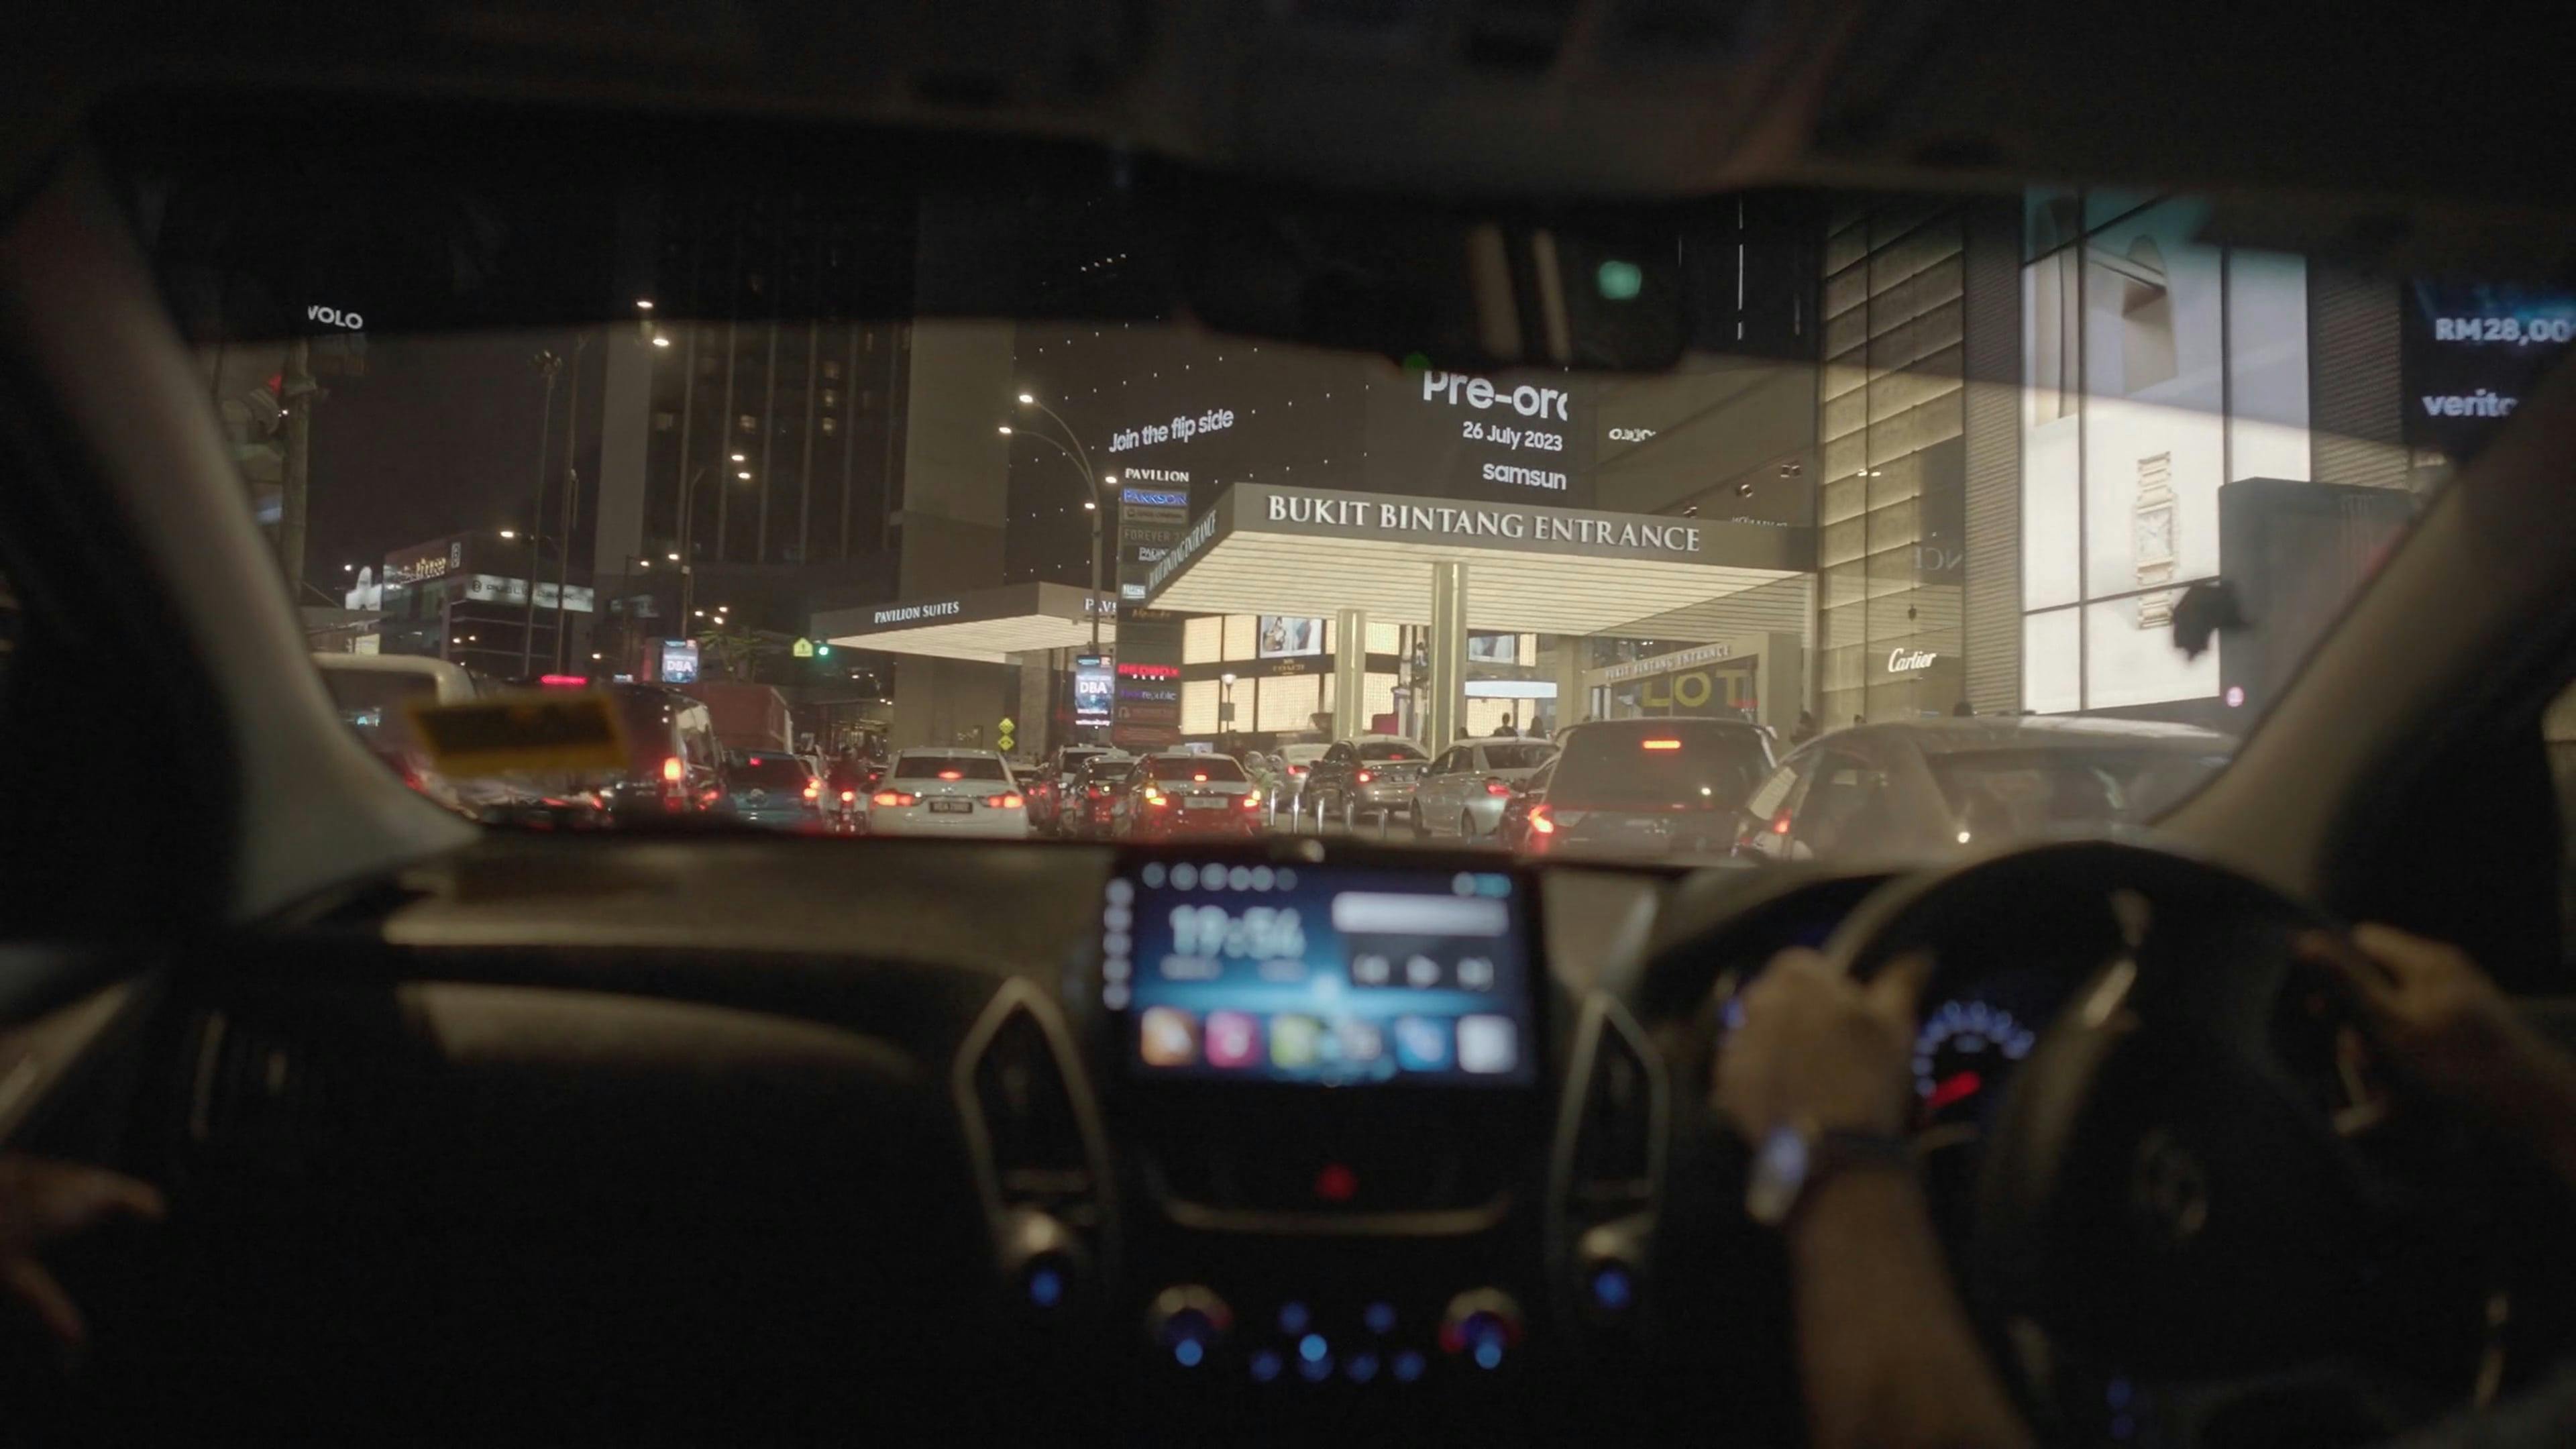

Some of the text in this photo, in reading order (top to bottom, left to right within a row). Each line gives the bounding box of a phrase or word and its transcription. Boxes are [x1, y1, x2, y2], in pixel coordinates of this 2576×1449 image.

[308, 305, 363, 329] VOLO
[1108, 409, 1234, 452] Join the flip side
[1462, 421, 1563, 451] 26 July 2023
[1125, 468, 1189, 482] PAVILION
[1483, 464, 1567, 490] samsun
[1269, 495, 1700, 552] BUKIT BINTANG ENTRANCE
[1124, 529, 1170, 543] FOREVER
[874, 601, 959, 624] PAVILION SUITES
[1888, 647, 1937, 672] Cartier
[1079, 681, 1108, 694] DBA
